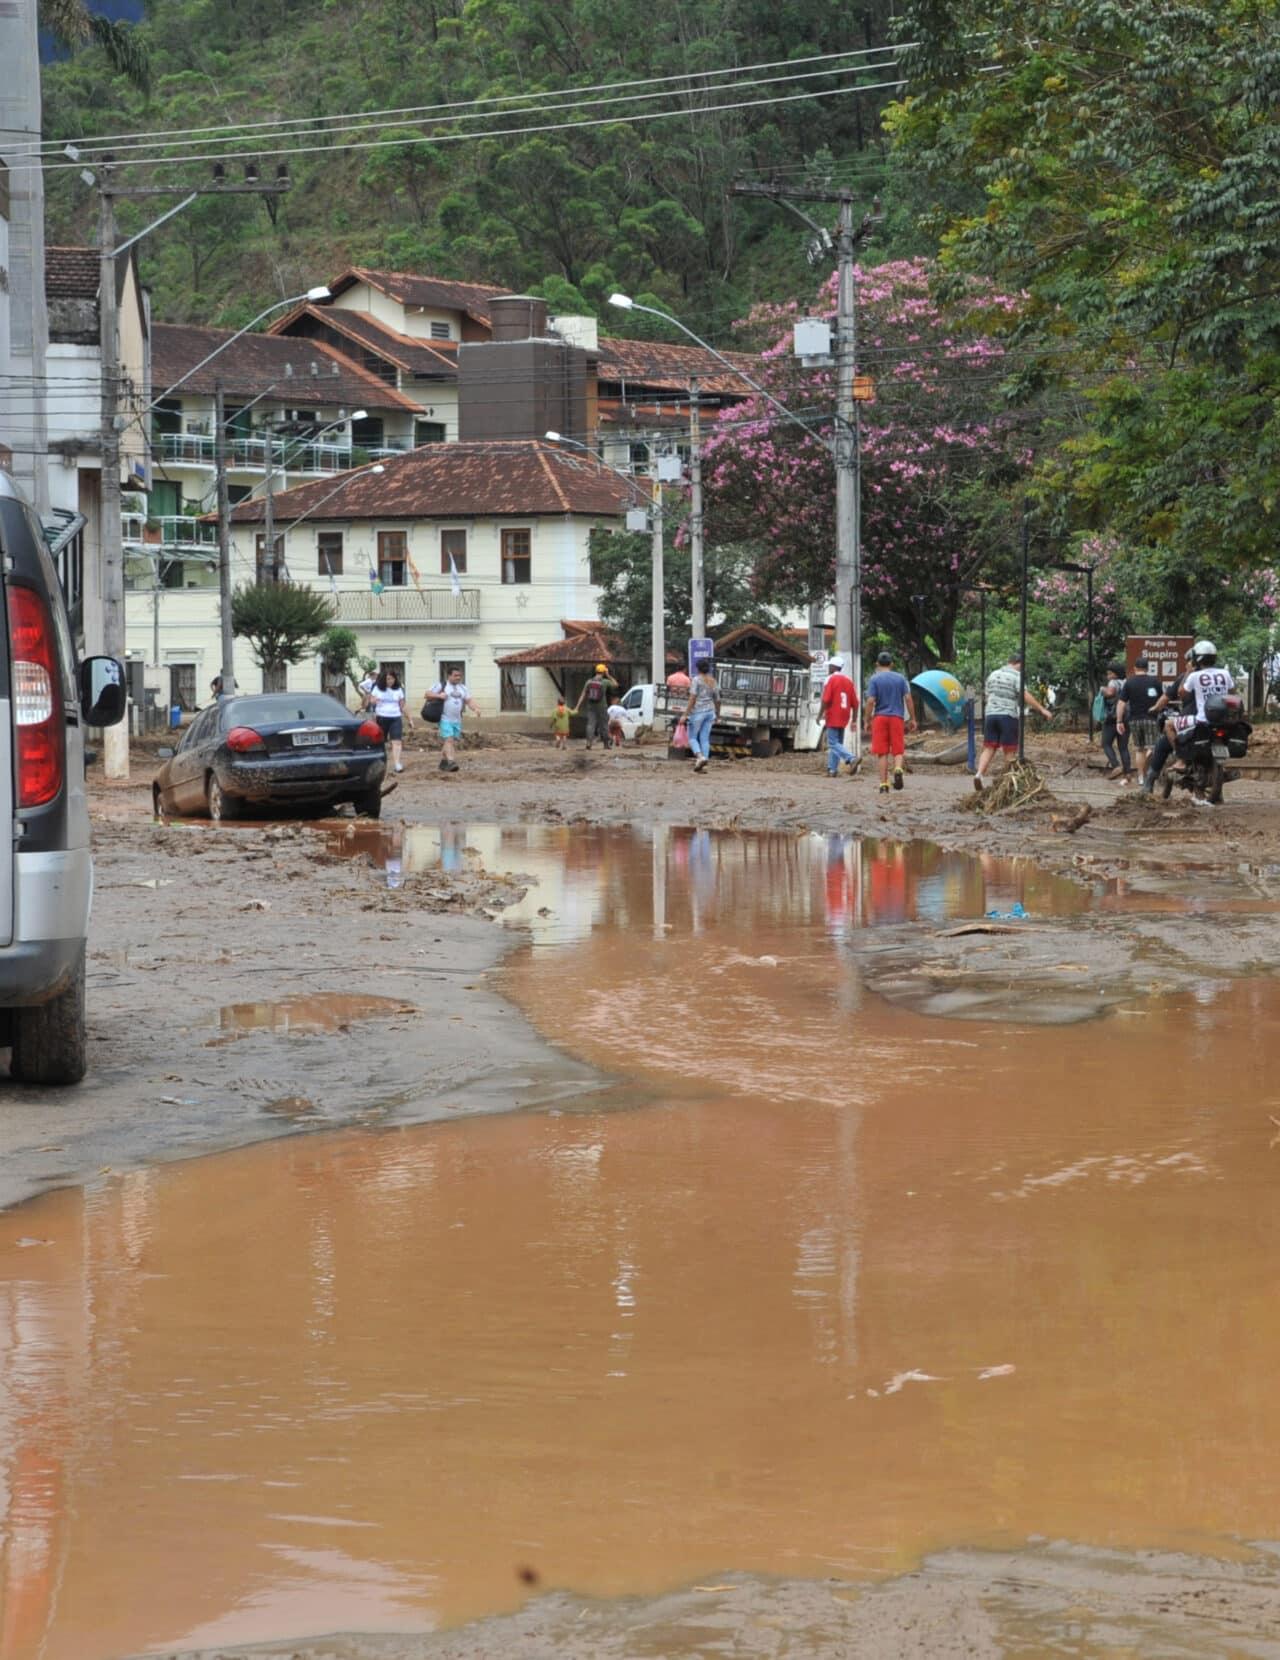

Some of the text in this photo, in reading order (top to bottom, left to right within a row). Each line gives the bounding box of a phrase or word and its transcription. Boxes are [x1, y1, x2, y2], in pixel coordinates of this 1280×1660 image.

[1144, 639, 1177, 649] Praça do
[1142, 649, 1178, 659] Suspiro
